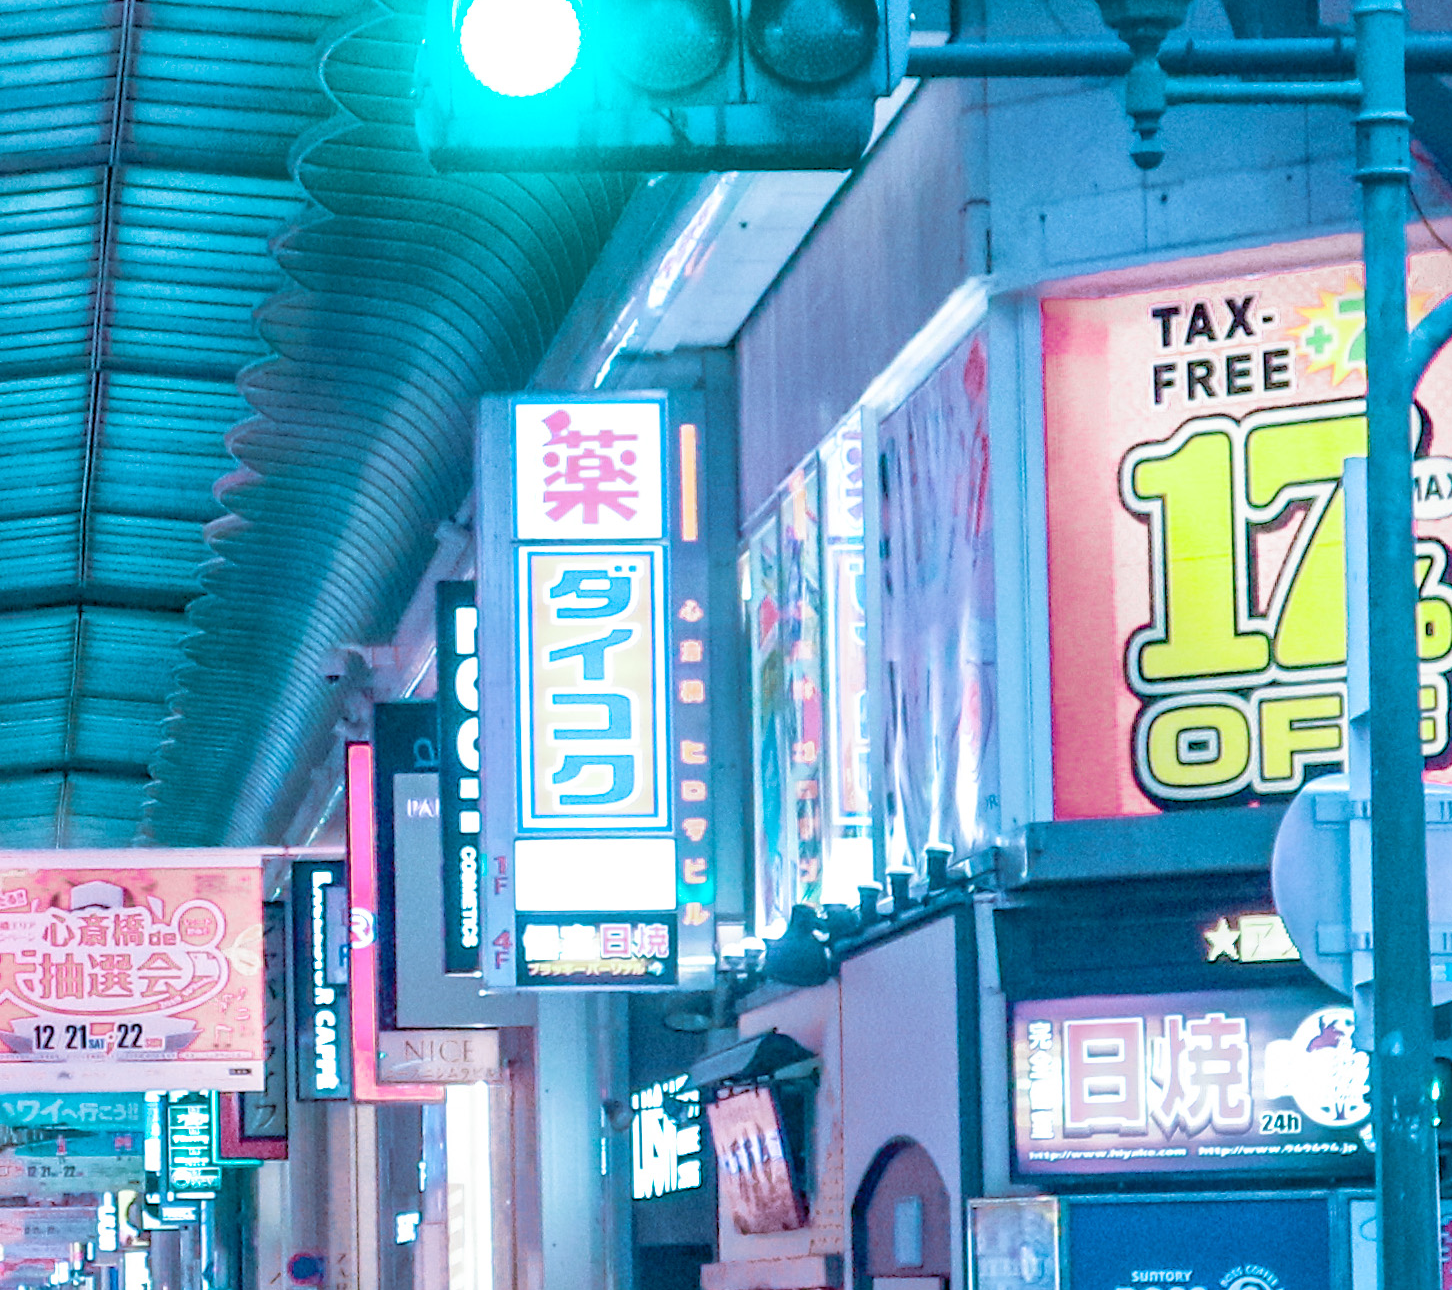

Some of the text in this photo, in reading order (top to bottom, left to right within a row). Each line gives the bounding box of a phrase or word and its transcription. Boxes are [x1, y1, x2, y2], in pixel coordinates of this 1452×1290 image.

[1151, 296, 1275, 349] TAX-
[1153, 347, 1292, 405] FREE
[542, 411, 640, 525] 薬
[548, 562, 640, 808] ダイコク
[34, 1024, 56, 1050] 12
[66, 1024, 88, 1050] 21
[117, 1023, 144, 1049] 22
[405, 1040, 475, 1063] NICE
[1063, 1012, 1253, 1135] 日焼
[1260, 1112, 1302, 1135] 24h
